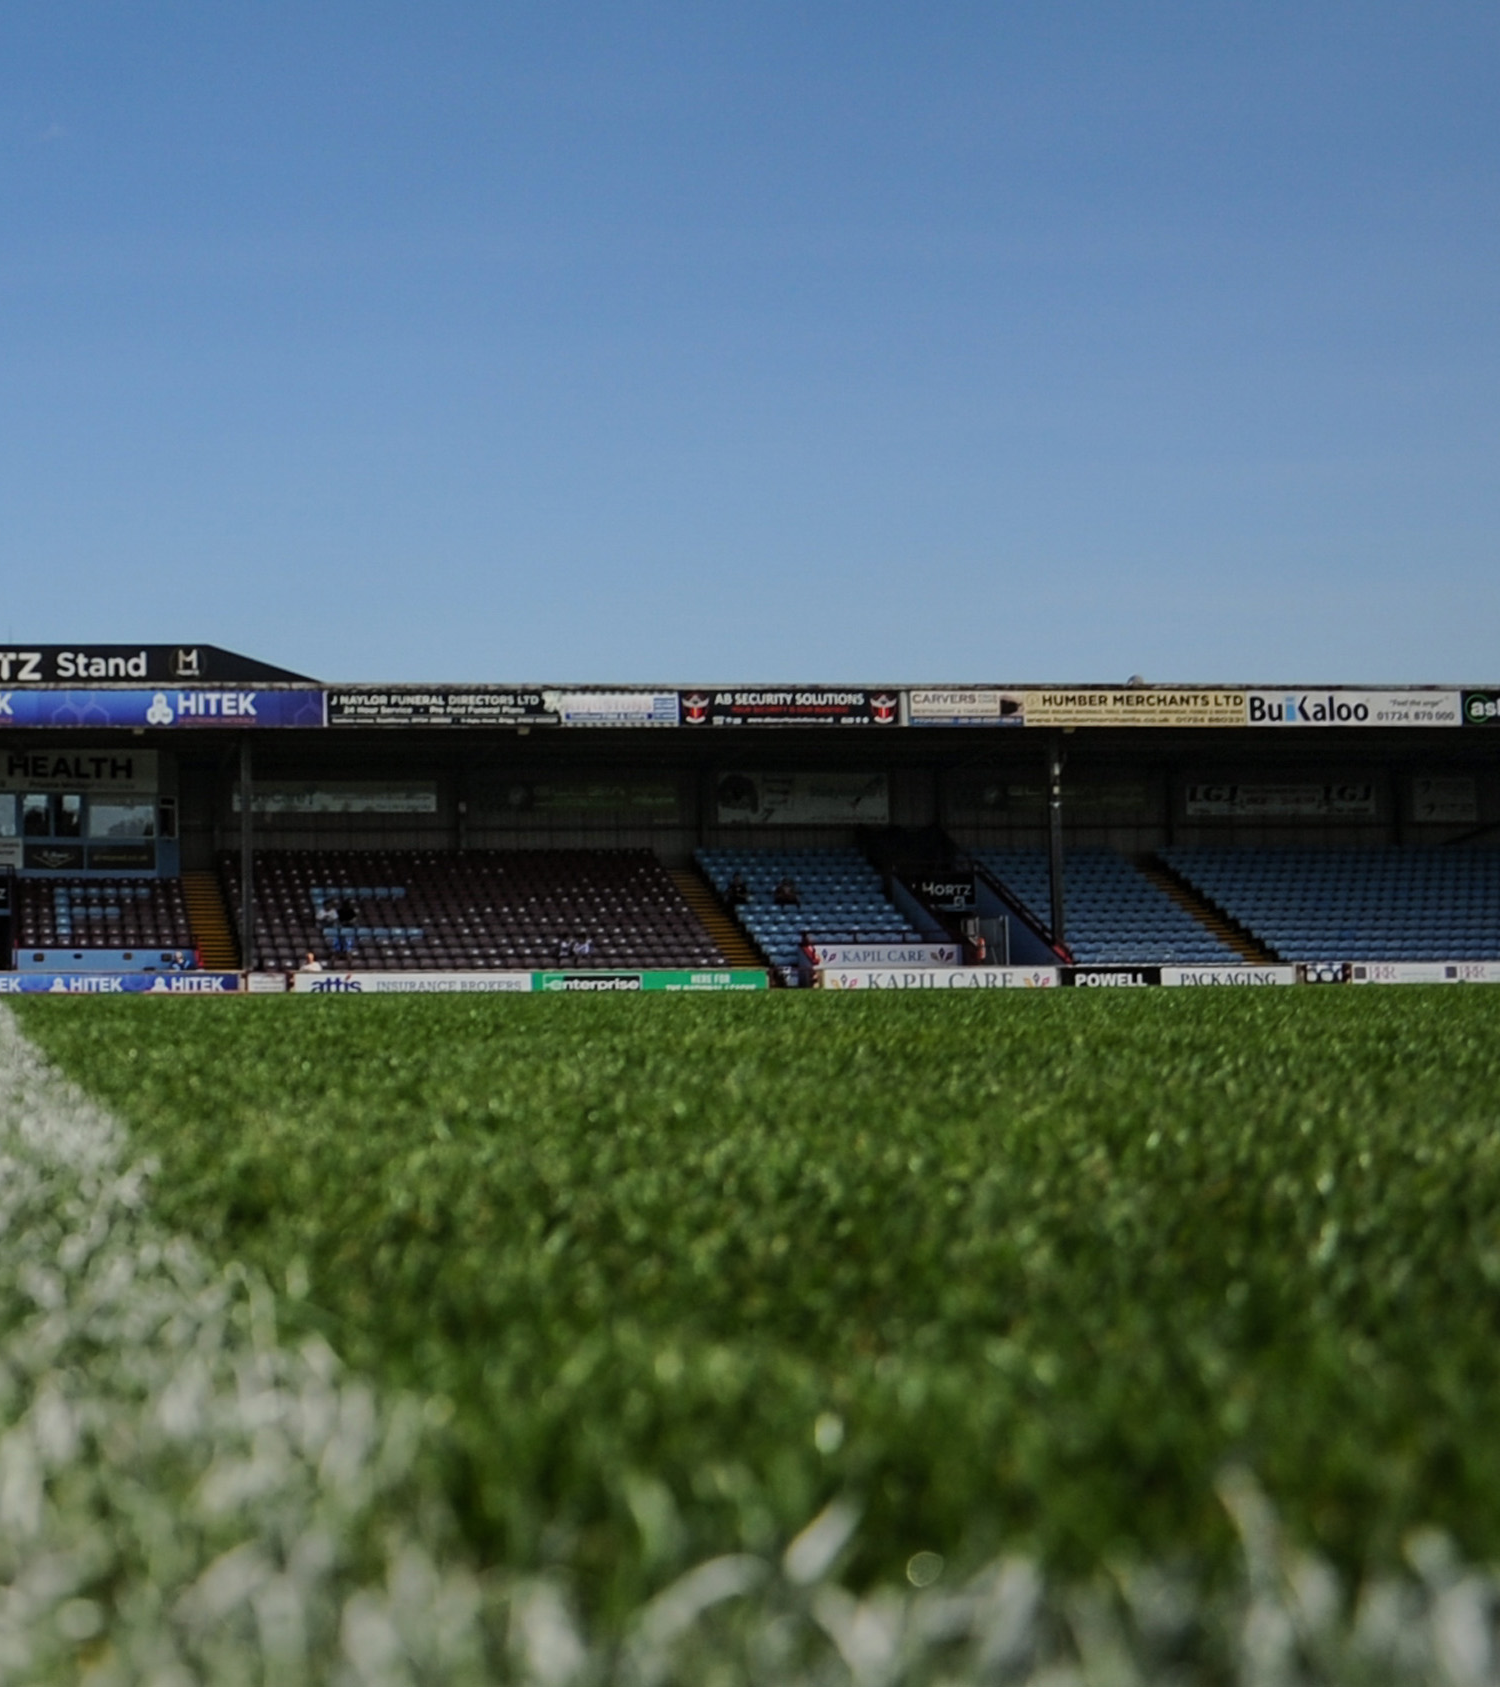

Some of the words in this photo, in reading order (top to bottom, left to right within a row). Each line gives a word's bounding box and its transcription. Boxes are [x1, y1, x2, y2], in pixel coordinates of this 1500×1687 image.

[56, 652, 148, 678] Stand
[178, 692, 258, 714] HITEK
[331, 695, 336, 706] J
[340, 695, 388, 706] NAYLOR
[390, 695, 445, 706] FUNERAL
[449, 695, 515, 706] DIRECTORS
[517, 695, 540, 705] LTD
[714, 693, 733, 705] AB
[735, 693, 792, 705] SECURITY
[795, 693, 865, 705] SOLUTIONS
[912, 693, 977, 705] CARVERS
[1042, 695, 1108, 707] HUMBER
[1112, 695, 1210, 706] MERCHANTS
[1214, 695, 1244, 706] LTD
[357, 706, 379, 715] Hour
[380, 706, 413, 714] Service
[446, 706, 466, 714] Paid
[467, 706, 500, 714] Funeral
[502, 706, 526, 714] Plans
[1377, 711, 1409, 721] 01724
[8, 755, 133, 779] HEALTH
[842, 950, 885, 962] KAPIL
[887, 949, 926, 962] CARE
[70, 976, 123, 992] HITEK
[171, 976, 224, 991] HITEK
[311, 974, 362, 992] attis
[376, 980, 456, 992] INSURANCE
[460, 980, 522, 992] BROKERS
[548, 975, 640, 990] enterprise
[867, 973, 936, 988] KAPIL
[949, 972, 1014, 988] CARE
[1074, 972, 1148, 988] POWELL
[1179, 971, 1276, 986] PACKAGING
